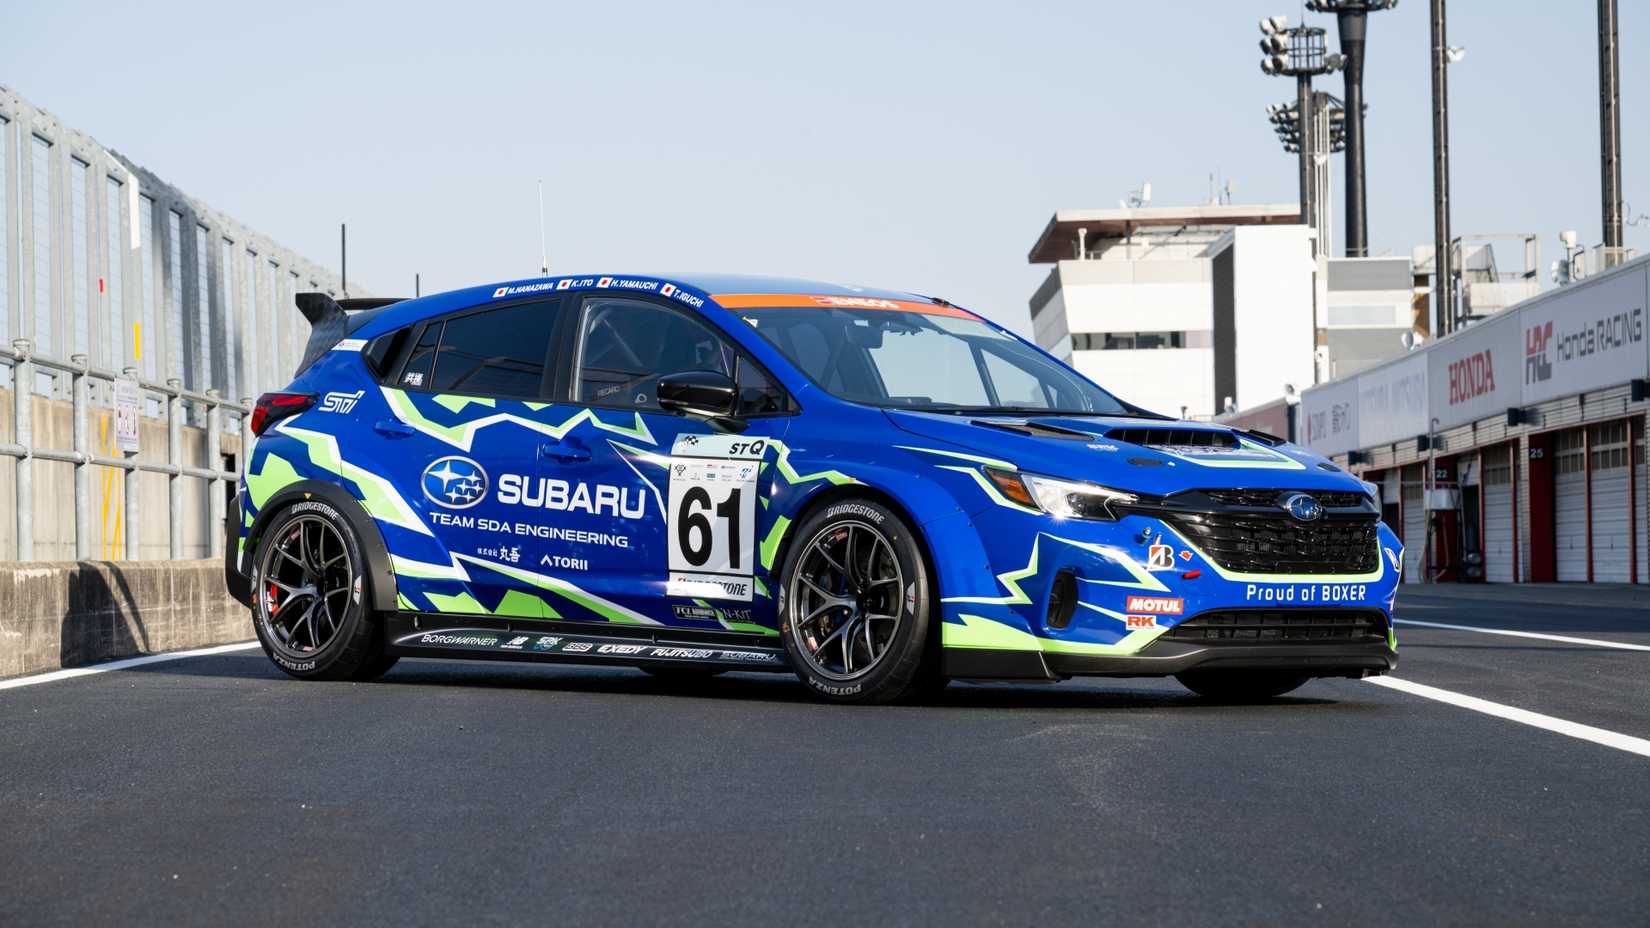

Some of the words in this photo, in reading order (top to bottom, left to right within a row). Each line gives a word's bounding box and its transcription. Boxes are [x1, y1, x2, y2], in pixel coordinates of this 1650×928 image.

[571, 279, 594, 288] K.ITO
[611, 278, 659, 290] H.YAMAUCHI
[1557, 321, 1595, 362] Honda
[1597, 307, 1642, 351] RACING
[1449, 350, 1496, 405] HONDA
[729, 440, 765, 455] STQ
[1530, 449, 1543, 459] 25
[1436, 469, 1447, 479] 22
[497, 473, 646, 519] SUBARU
[291, 502, 338, 520] BRIDGESTONE
[826, 504, 885, 524] BRIDGESTONE
[430, 511, 474, 528] TEAM
[478, 519, 512, 534] SDA
[515, 523, 629, 548] ENGINEERING
[678, 486, 741, 570] 61
[1247, 584, 1294, 601] Proud
[1301, 585, 1316, 601] of
[1322, 585, 1366, 601] BOXER
[1129, 598, 1180, 612] MOTUL
[1127, 616, 1154, 627] RK
[421, 634, 498, 646] BORGWARNER
[597, 644, 648, 654] EXEDY
[650, 647, 713, 658] FUJITSUBO
[273, 653, 315, 671] POTENZA
[808, 676, 862, 696] POTENZA
